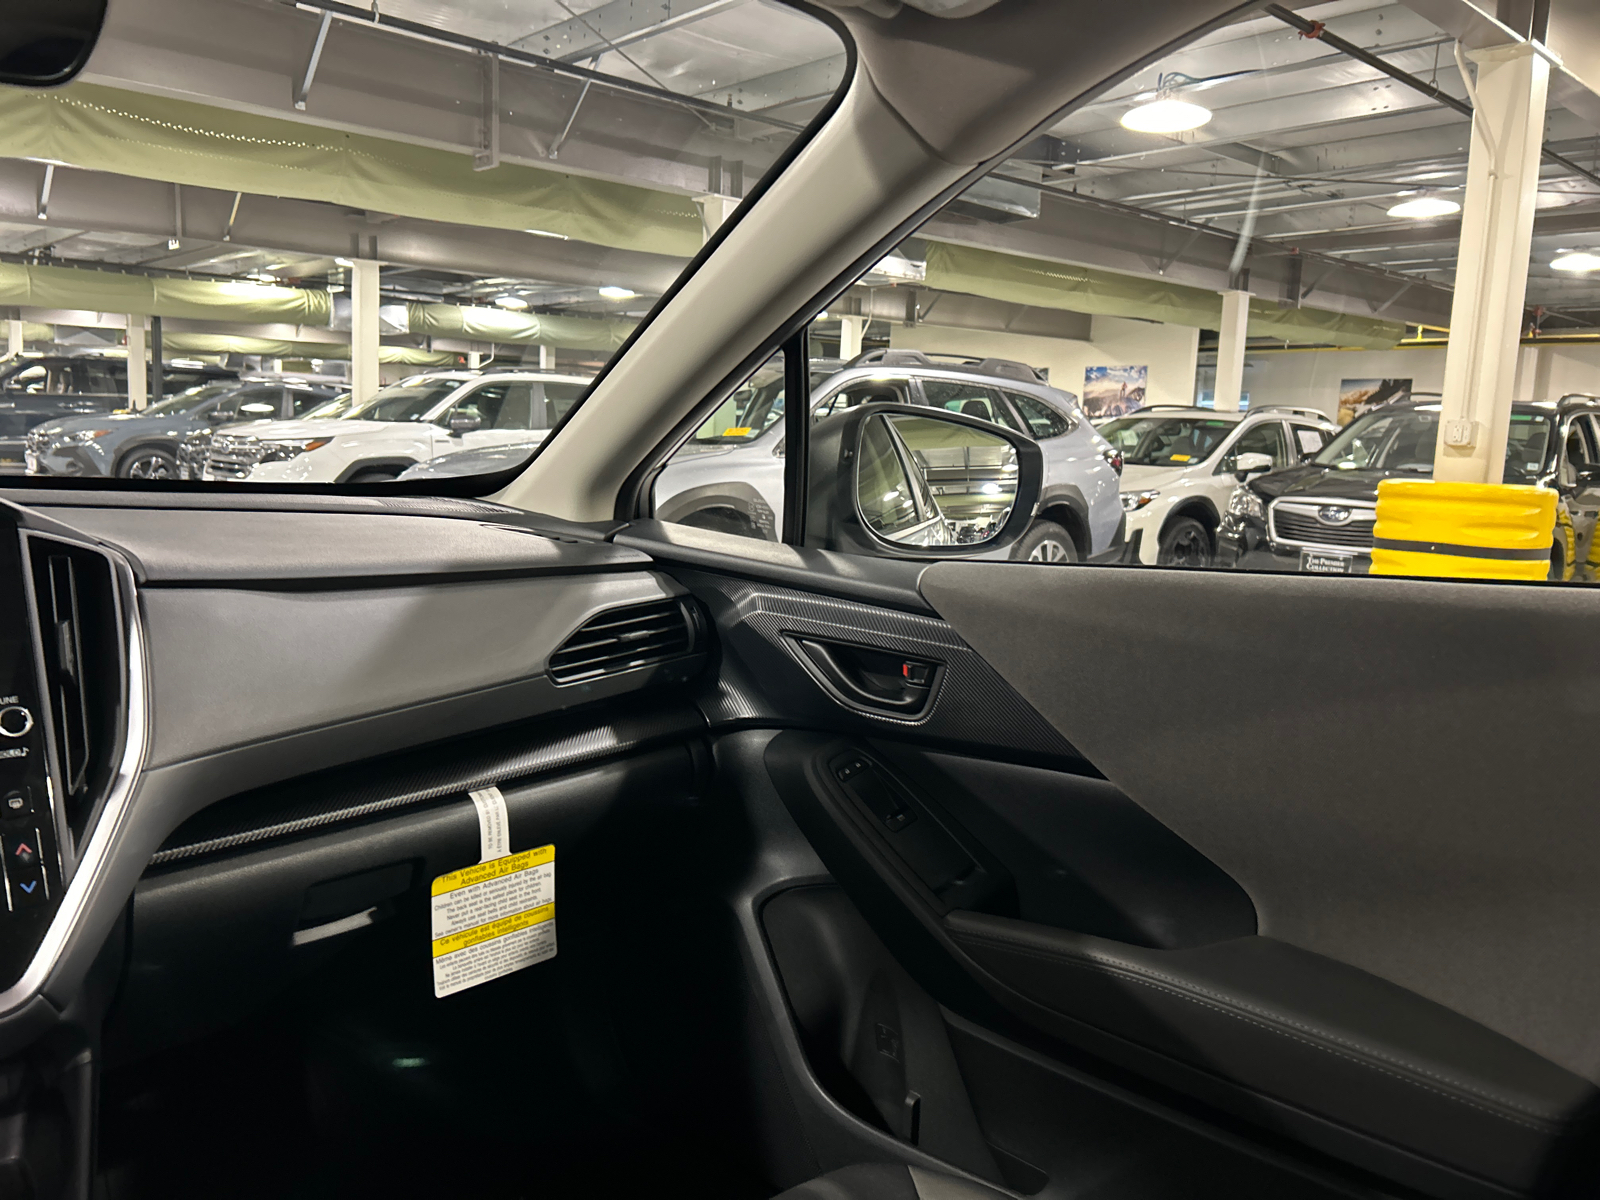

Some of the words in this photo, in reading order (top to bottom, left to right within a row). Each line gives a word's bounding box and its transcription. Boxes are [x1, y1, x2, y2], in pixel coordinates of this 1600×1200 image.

[442, 874, 457, 883] This
[460, 865, 486, 877] Vehicle
[498, 852, 531, 867] Equipped
[533, 848, 547, 856] with
[461, 870, 496, 885] Advanced
[511, 861, 529, 873] Bags
[450, 890, 466, 899] Even
[483, 876, 512, 889] Advanced
[524, 869, 539, 877] Bags
[452, 930, 478, 942] véhicule
[480, 925, 490, 933] est
[524, 906, 549, 919] coussins
[463, 931, 495, 947] gonflables
[497, 920, 529, 936] intelligents
